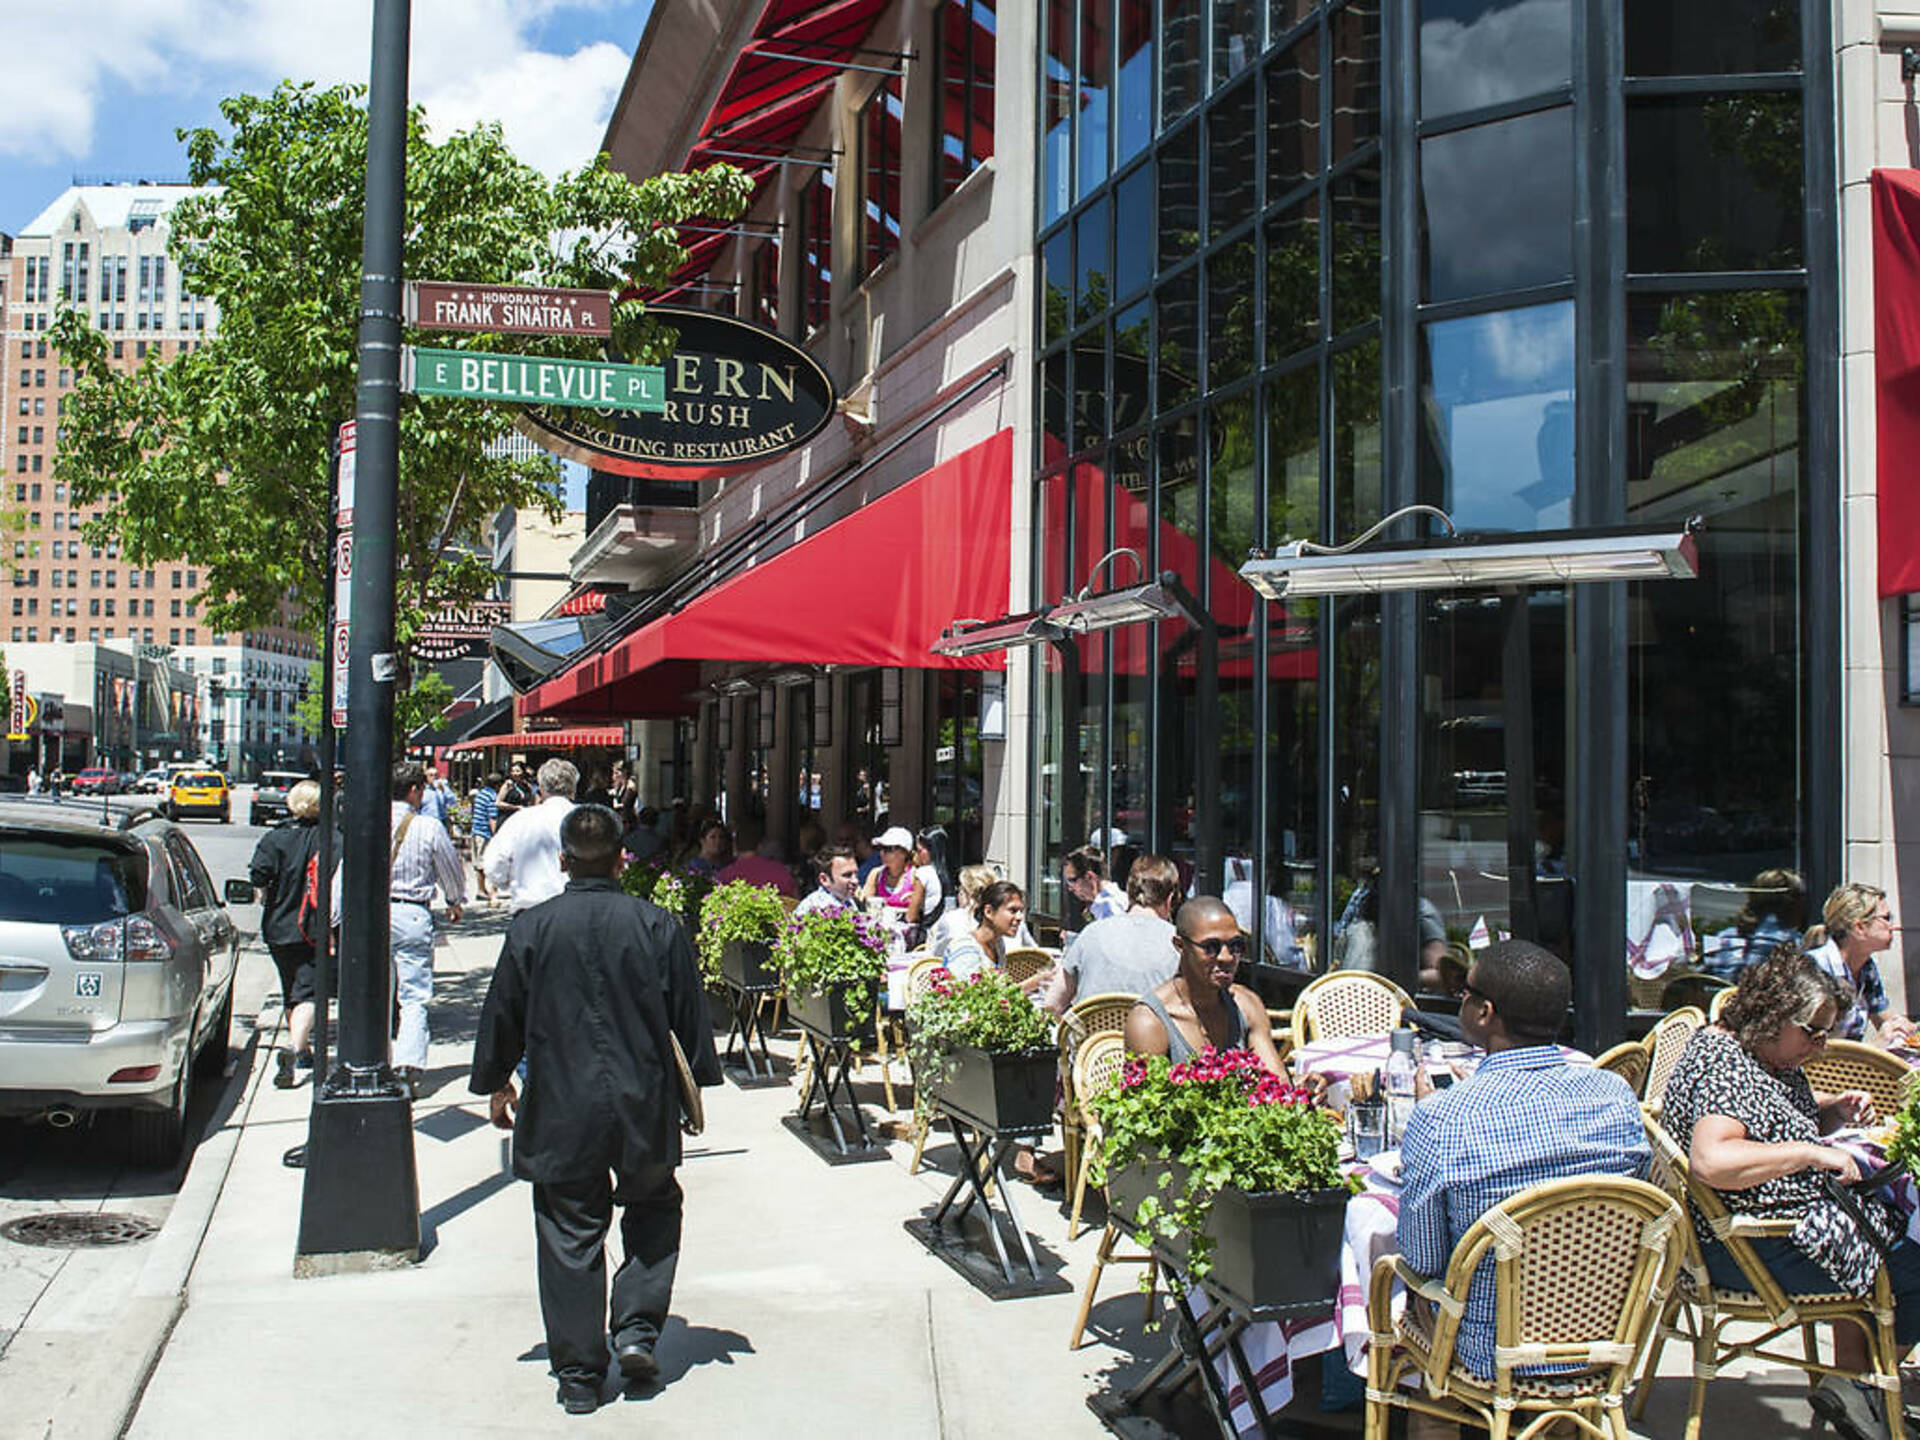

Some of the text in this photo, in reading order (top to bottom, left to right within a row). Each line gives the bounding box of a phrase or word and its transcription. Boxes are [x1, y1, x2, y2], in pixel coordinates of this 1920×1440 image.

[482, 292, 549, 306] HONORARY
[435, 301, 596, 328] FRANK SINATRA PL
[435, 358, 652, 402] E BELLEVUE PL
[673, 354, 800, 403] ERN
[661, 401, 750, 428] RUSH
[673, 422, 796, 458] RESTAURANT
[425, 607, 502, 625] MINE'S
